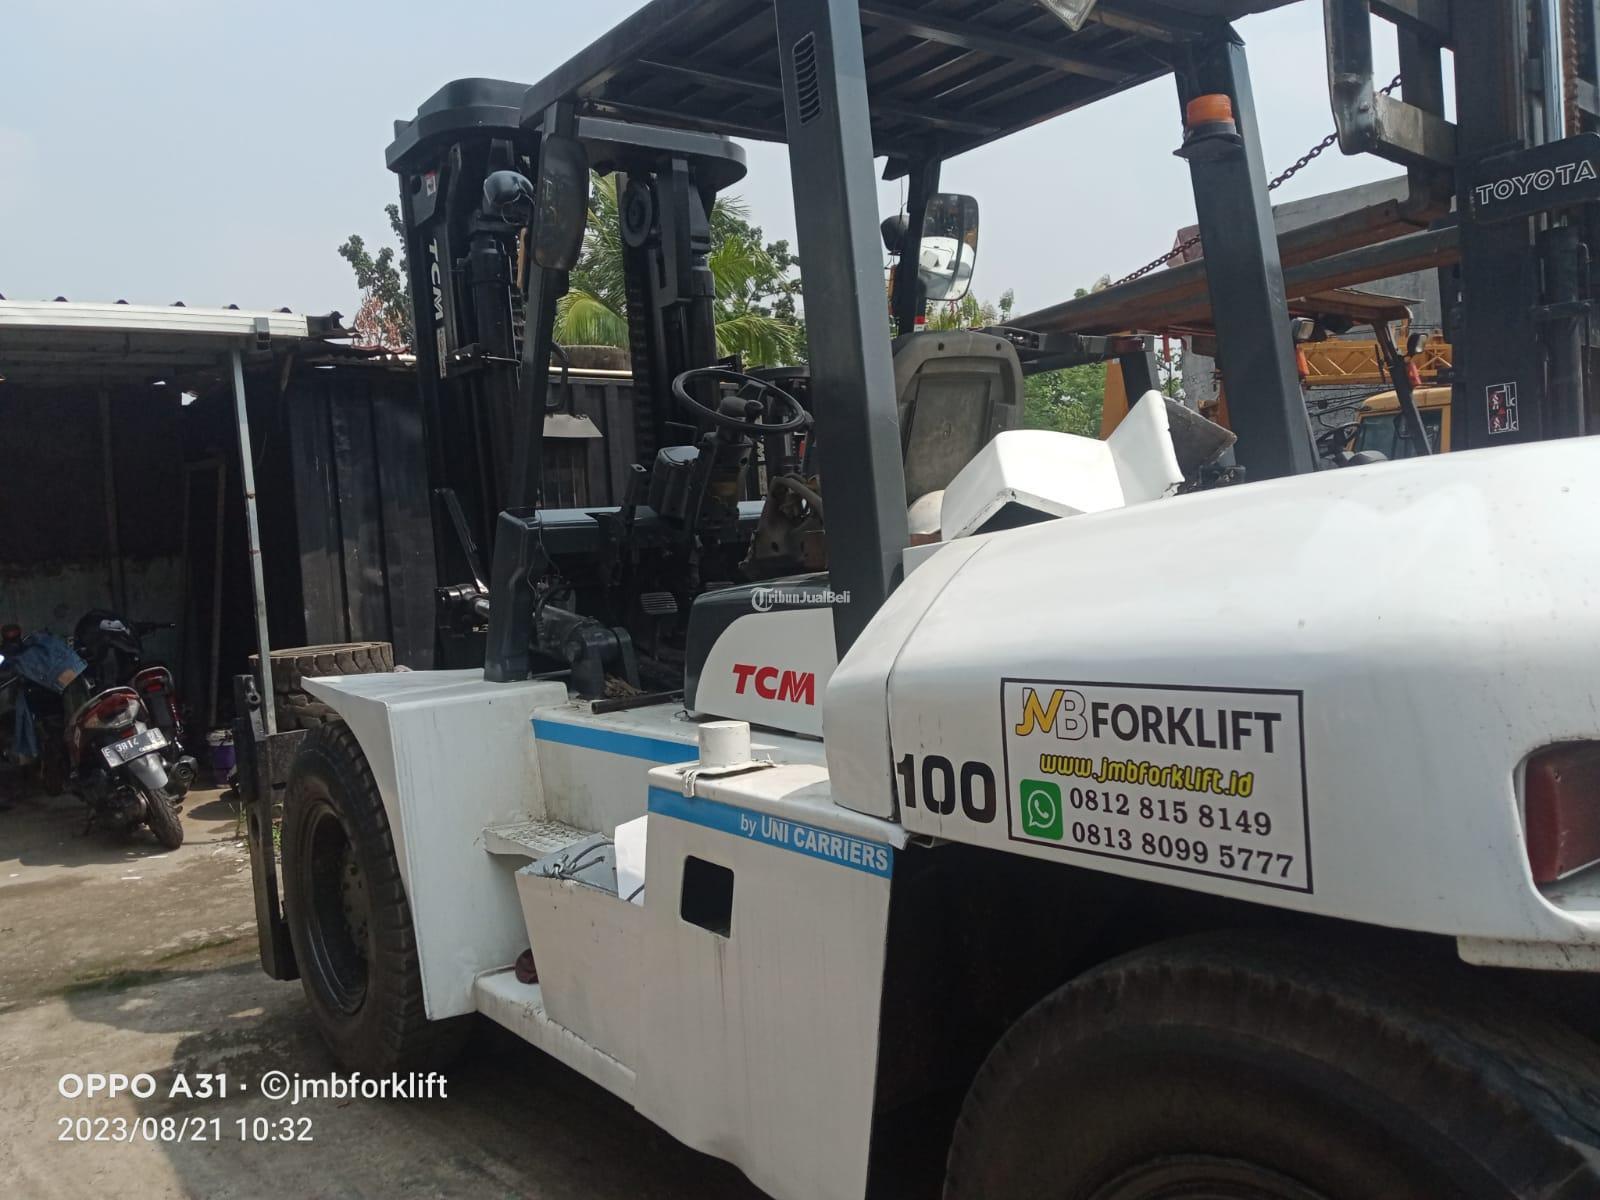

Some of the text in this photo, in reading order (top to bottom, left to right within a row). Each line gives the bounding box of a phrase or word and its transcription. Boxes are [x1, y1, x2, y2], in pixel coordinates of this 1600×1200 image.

[1475, 160, 1597, 205] TOYOTA
[428, 237, 444, 321] TCM
[732, 663, 815, 706] TCM
[1090, 702, 1282, 754] FORKLIFT
[896, 753, 997, 824] 100
[1069, 787, 1272, 837] 0812 815 8149
[740, 813, 888, 871] by UNI CARRIERS
[1072, 821, 1294, 878] 0813 8099 5777
